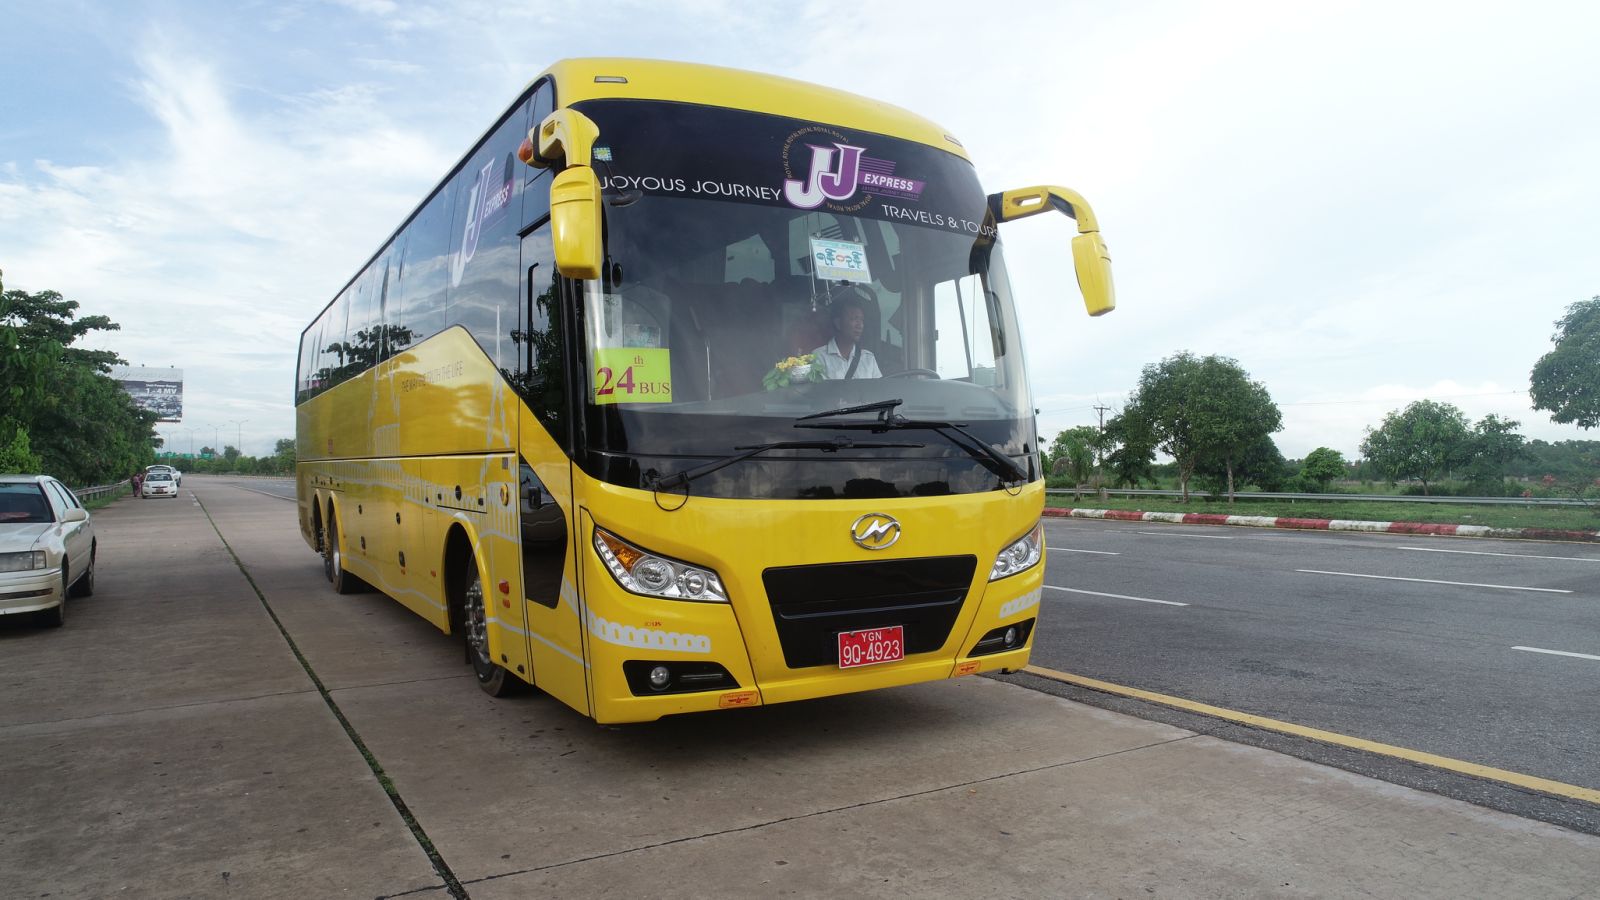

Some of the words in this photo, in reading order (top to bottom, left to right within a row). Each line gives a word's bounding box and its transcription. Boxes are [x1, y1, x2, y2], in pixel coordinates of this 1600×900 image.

[600, 175, 686, 192] JOYOUS
[692, 180, 781, 201] JOURNEY
[863, 172, 914, 191] EXPRESS
[881, 204, 944, 226] TRAVELS
[948, 216, 958, 229] &
[596, 366, 636, 396] 24
[640, 383, 671, 395] BUS
[861, 631, 882, 642] YGN
[843, 640, 900, 664] 90-4923
